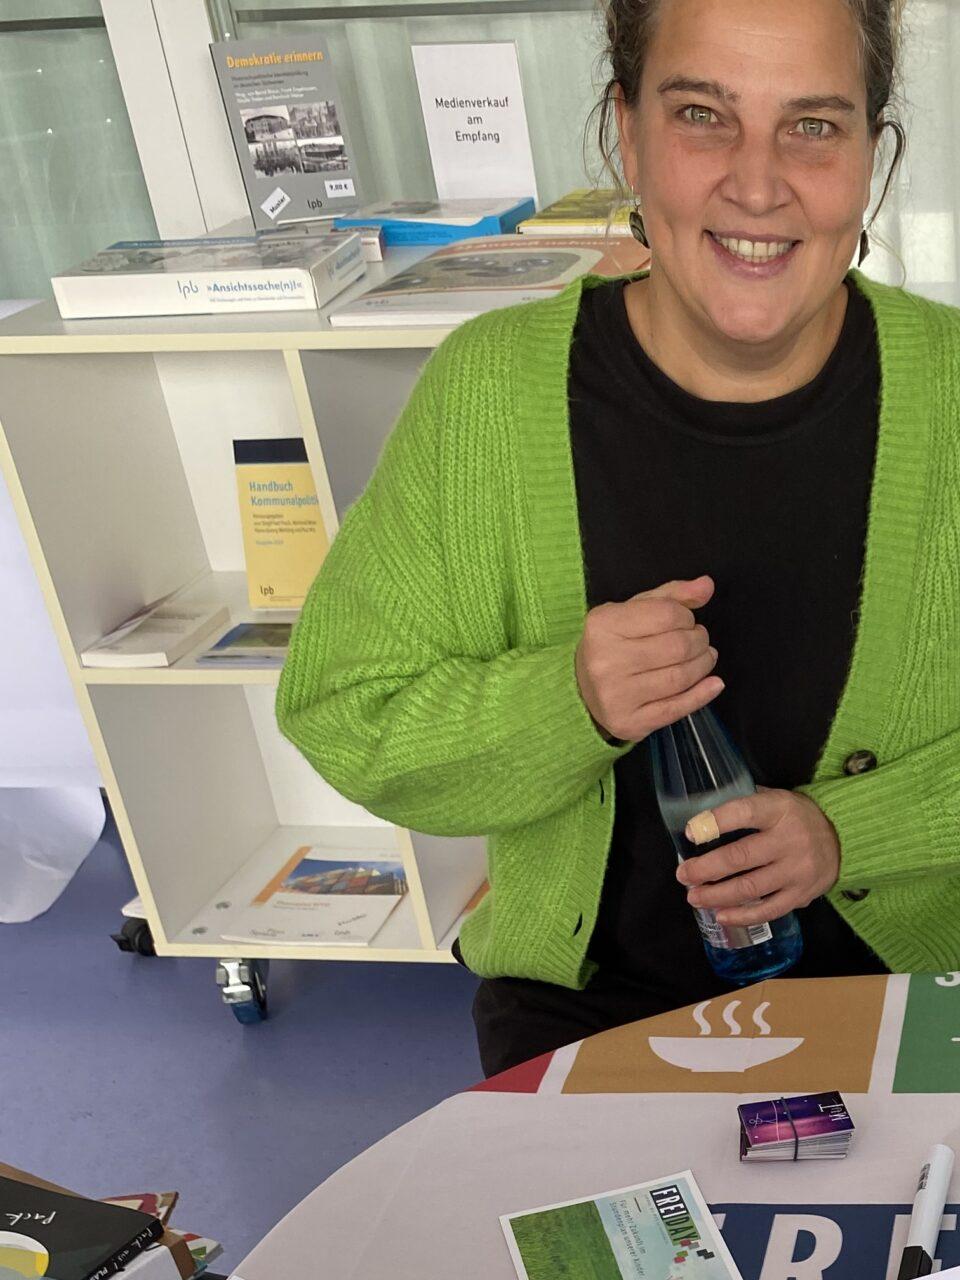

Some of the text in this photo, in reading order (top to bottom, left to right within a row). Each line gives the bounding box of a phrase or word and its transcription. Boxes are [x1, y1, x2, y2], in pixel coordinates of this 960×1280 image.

[226, 50, 324, 68] Demokratie erinnern
[434, 96, 509, 109] Medienverkauf
[467, 115, 483, 125] am
[455, 130, 500, 144] Empfang
[269, 194, 286, 214] Muster
[307, 199, 323, 210] lpb
[249, 480, 294, 492] Handbuch
[259, 585, 275, 597] lpb
